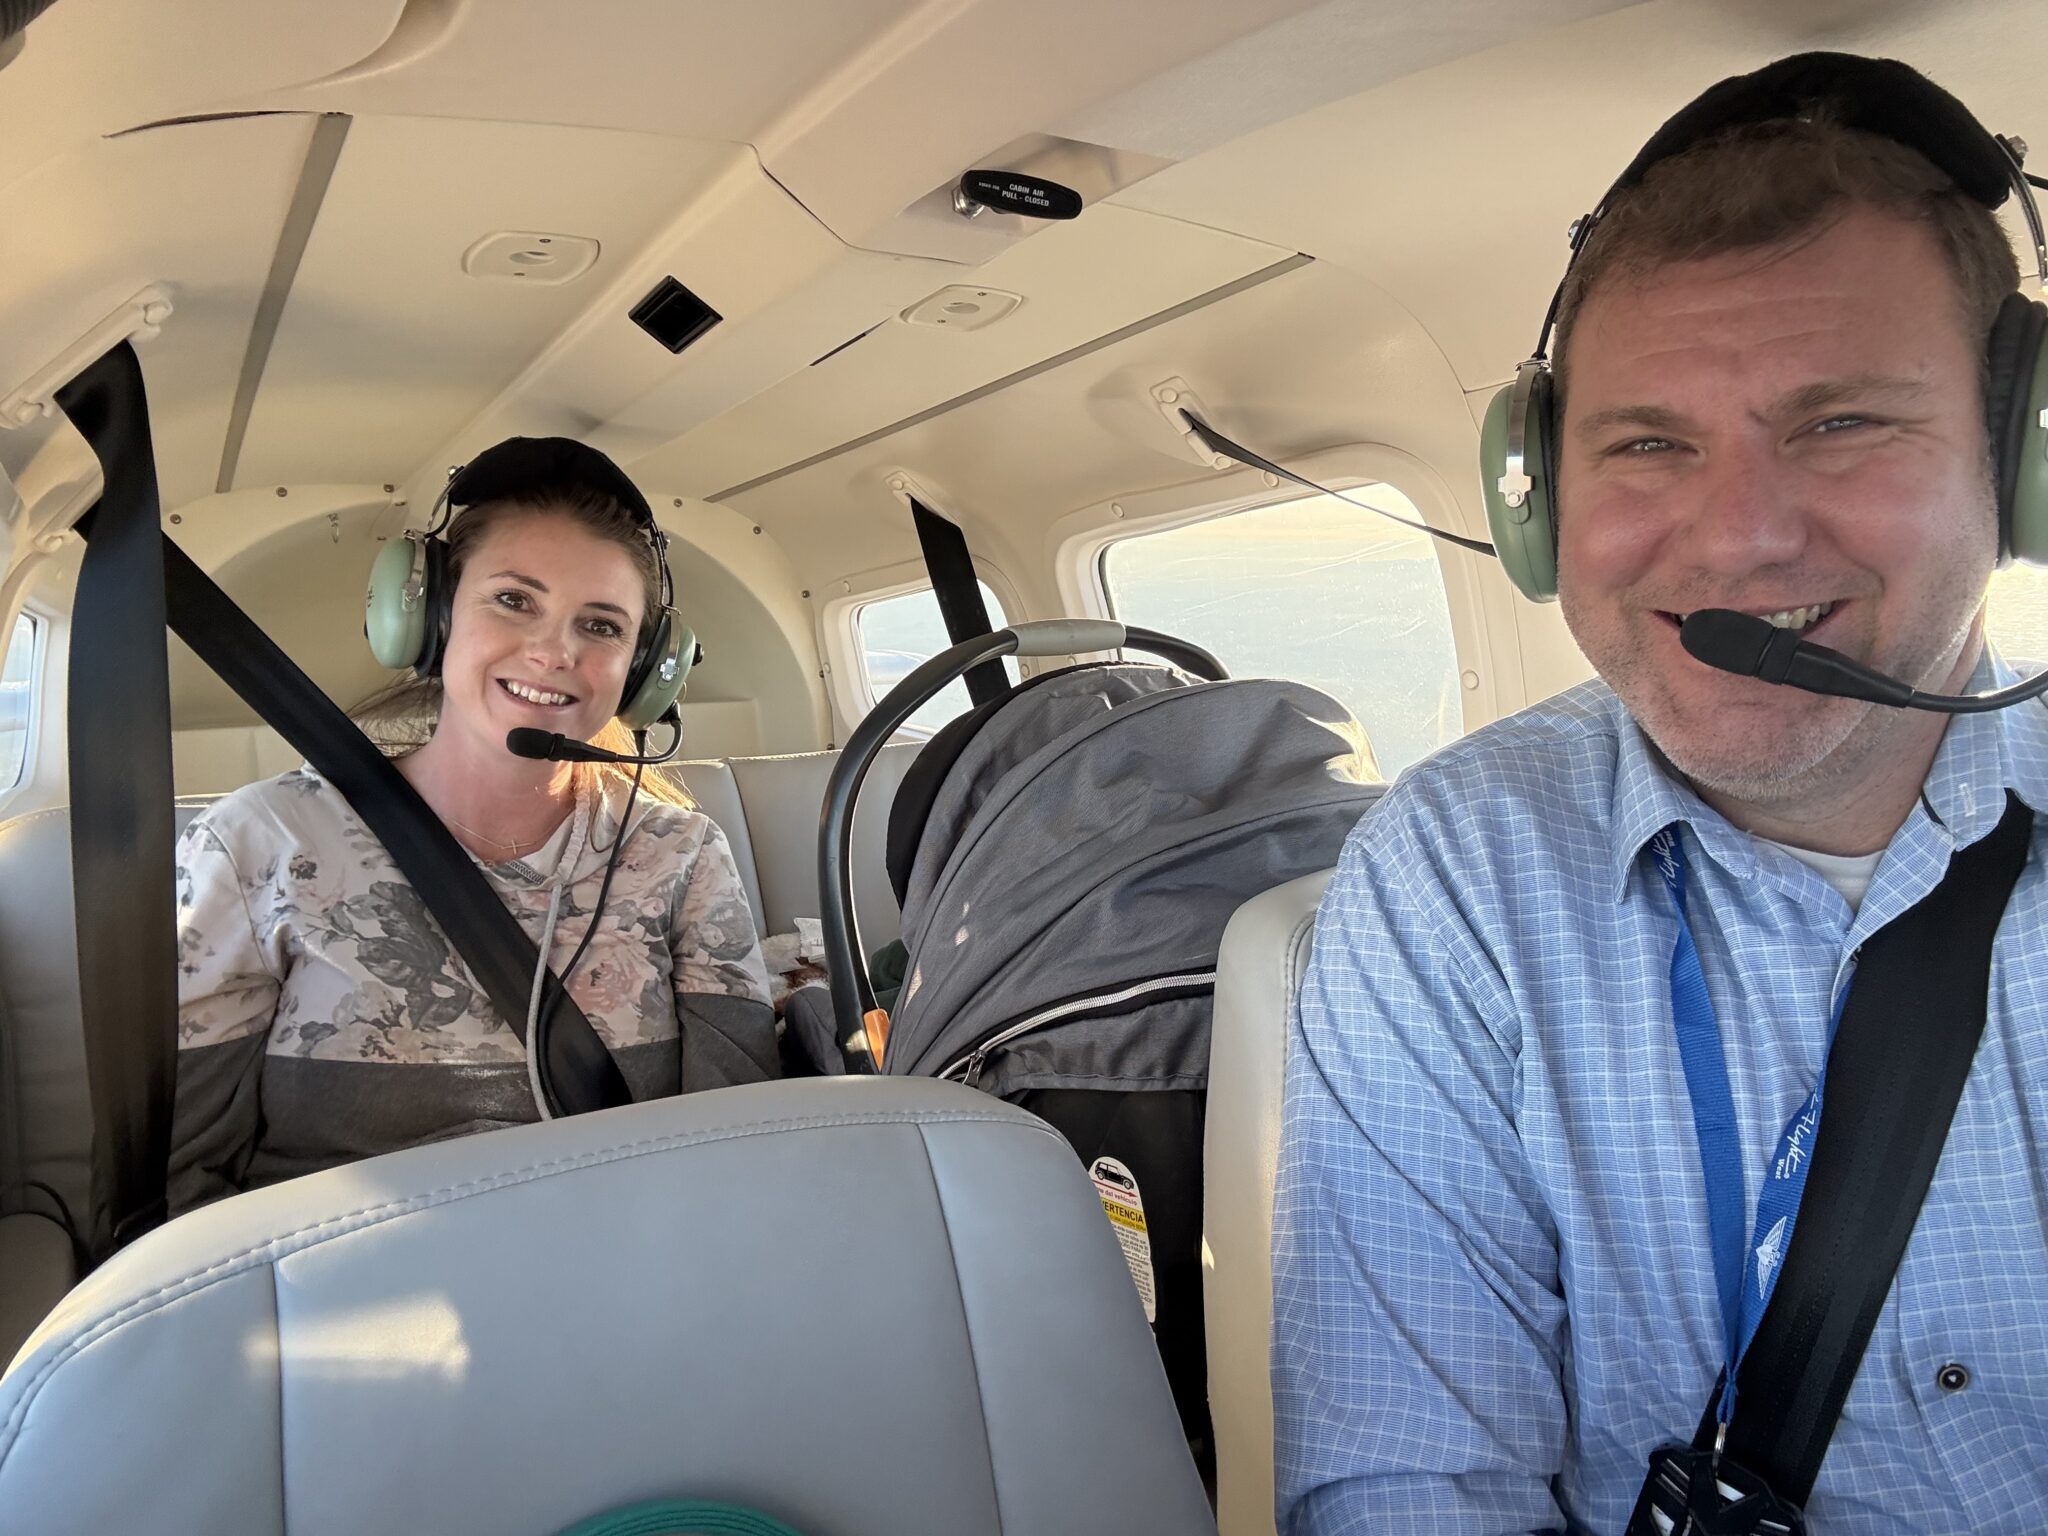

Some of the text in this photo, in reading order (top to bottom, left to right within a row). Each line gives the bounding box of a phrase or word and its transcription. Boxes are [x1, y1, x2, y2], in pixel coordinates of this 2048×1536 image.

[1002, 190, 1018, 200] PULL
[1024, 195, 1050, 207] CLOSED
[1009, 183, 1030, 194] CABIN
[1032, 189, 1045, 197] AIR
[1775, 1159, 1785, 1180] West
[1102, 1200, 1144, 1225] ERTENCIA
